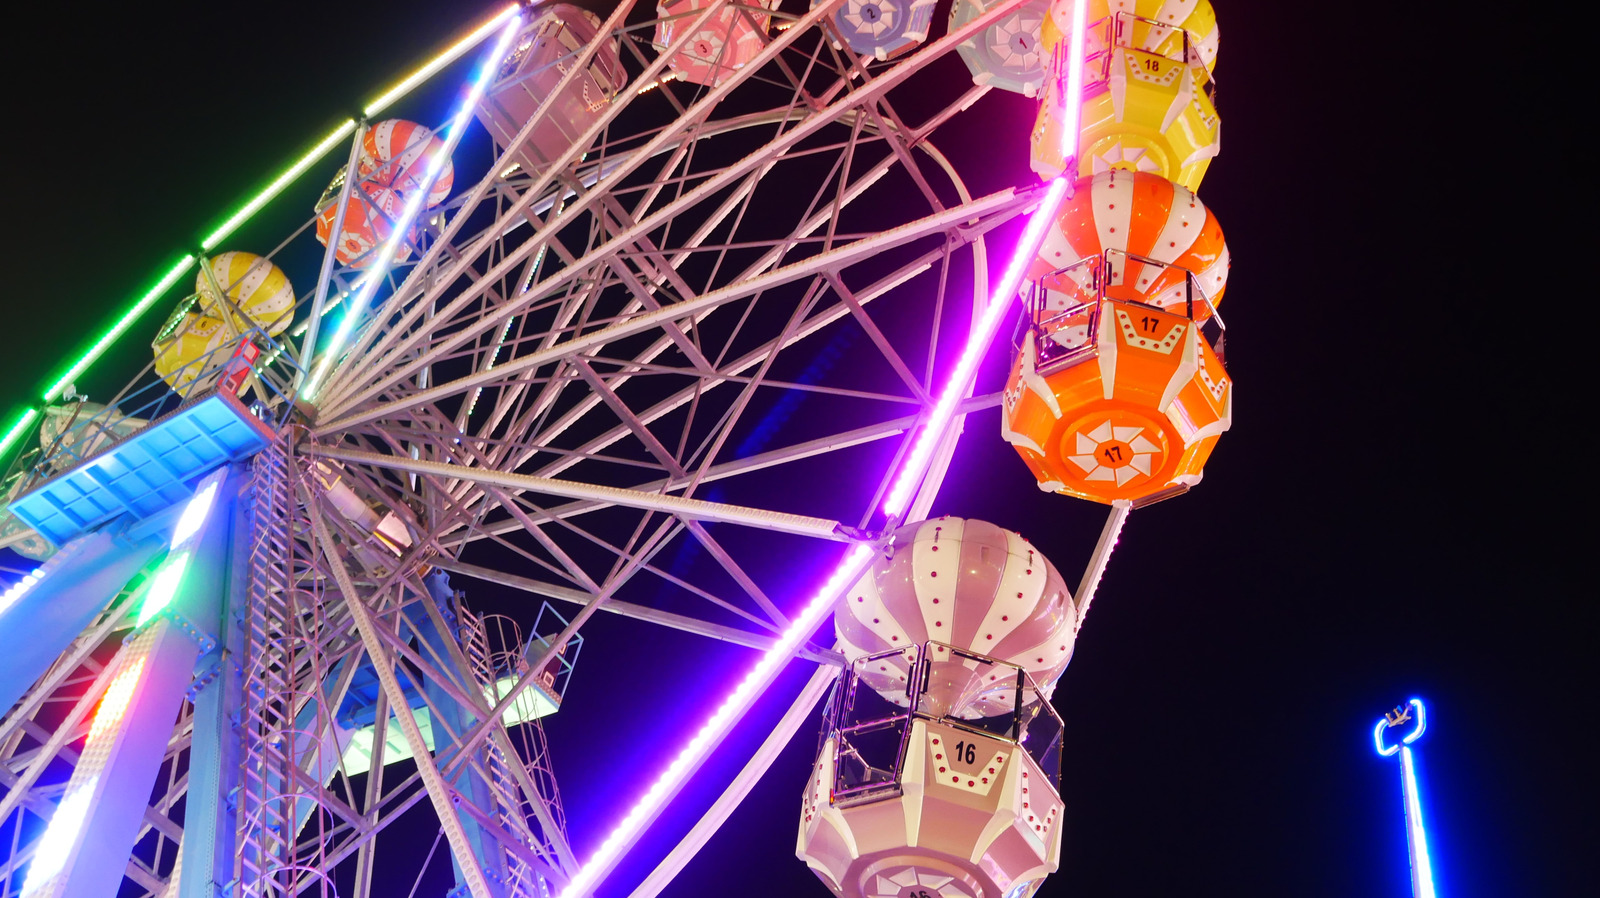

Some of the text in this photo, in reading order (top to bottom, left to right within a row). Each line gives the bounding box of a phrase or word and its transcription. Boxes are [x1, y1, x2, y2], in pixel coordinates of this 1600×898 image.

[867, 8, 876, 19] 2
[700, 44, 708, 54] 3
[1145, 59, 1159, 72] 18
[200, 320, 207, 328] 6
[1142, 316, 1159, 333] 17
[1104, 446, 1122, 463] 17
[954, 741, 976, 765] 16
